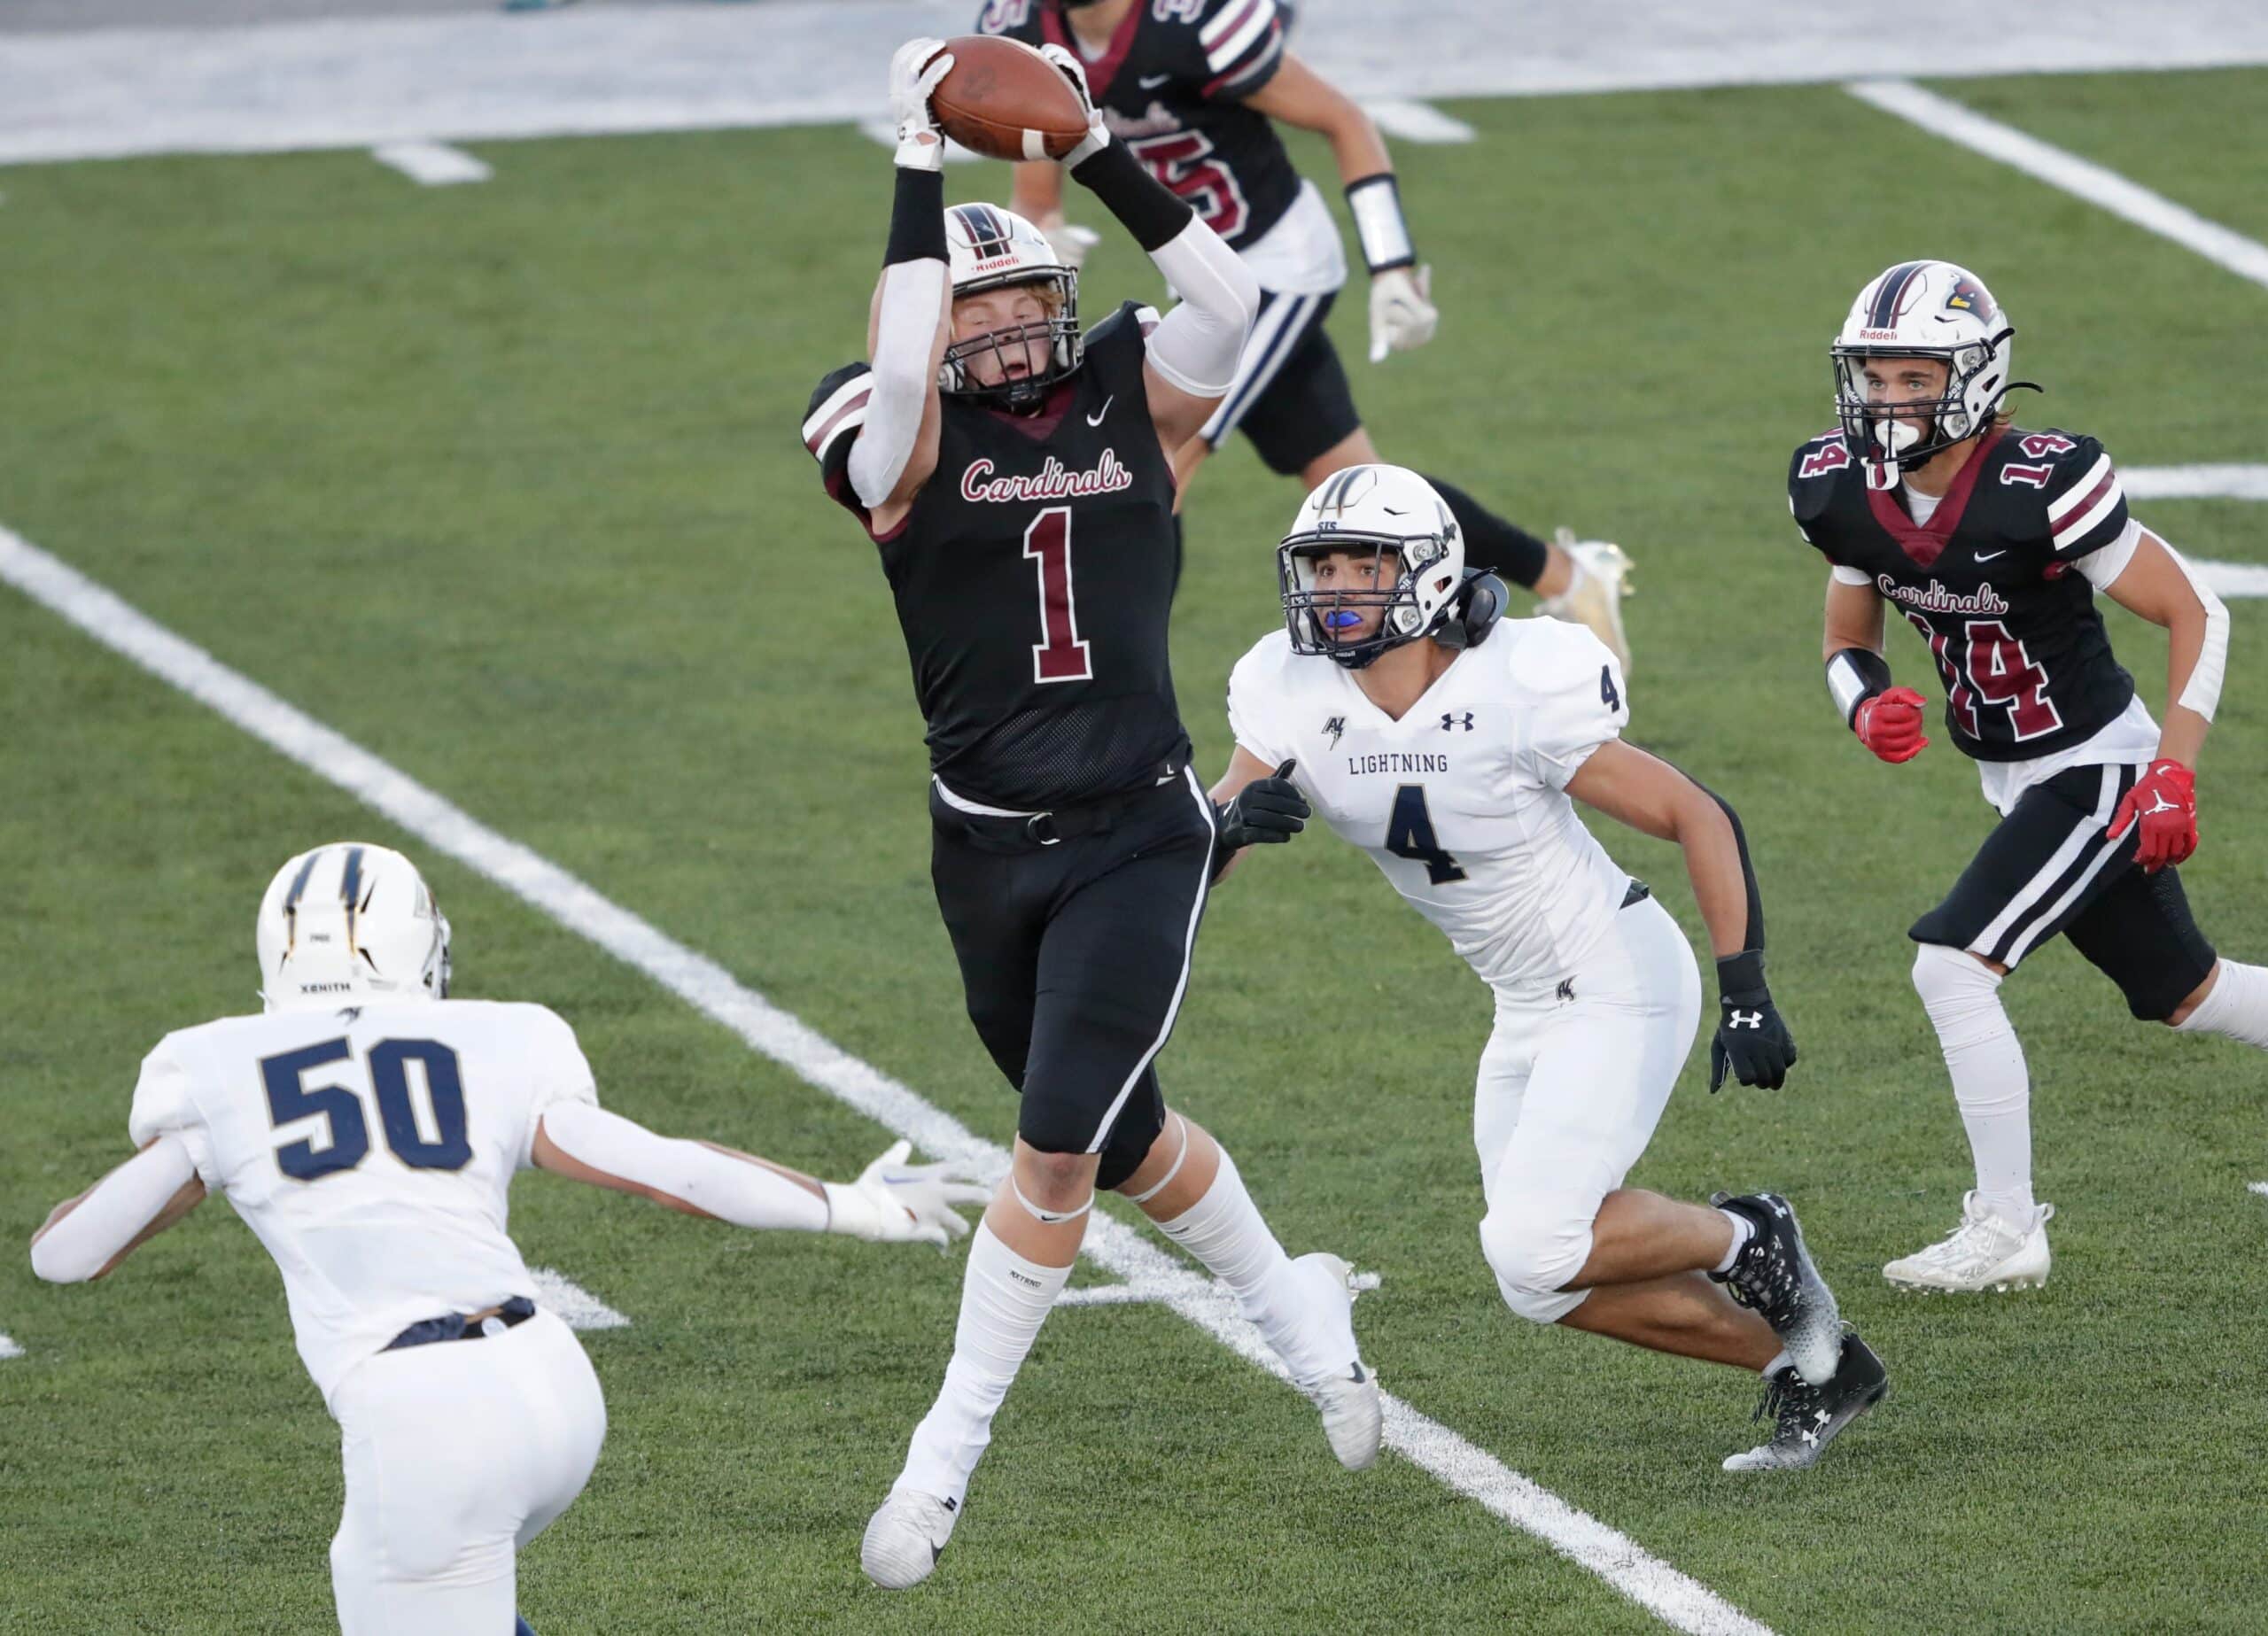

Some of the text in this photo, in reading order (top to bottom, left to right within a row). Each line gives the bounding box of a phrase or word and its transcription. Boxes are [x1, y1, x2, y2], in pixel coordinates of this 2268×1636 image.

[960, 447, 1132, 502] Cardinals
[2000, 434, 2078, 489] 14
[1022, 506, 1093, 684] 1
[1877, 573, 2008, 615] Cardinals
[1601, 664, 1619, 713] 4
[1905, 610, 2064, 742] 14
[1348, 753, 1448, 775] LIGHTNING
[1384, 782, 1470, 885] 4
[300, 982, 351, 993] XENITH
[257, 1035, 476, 1183] 50
